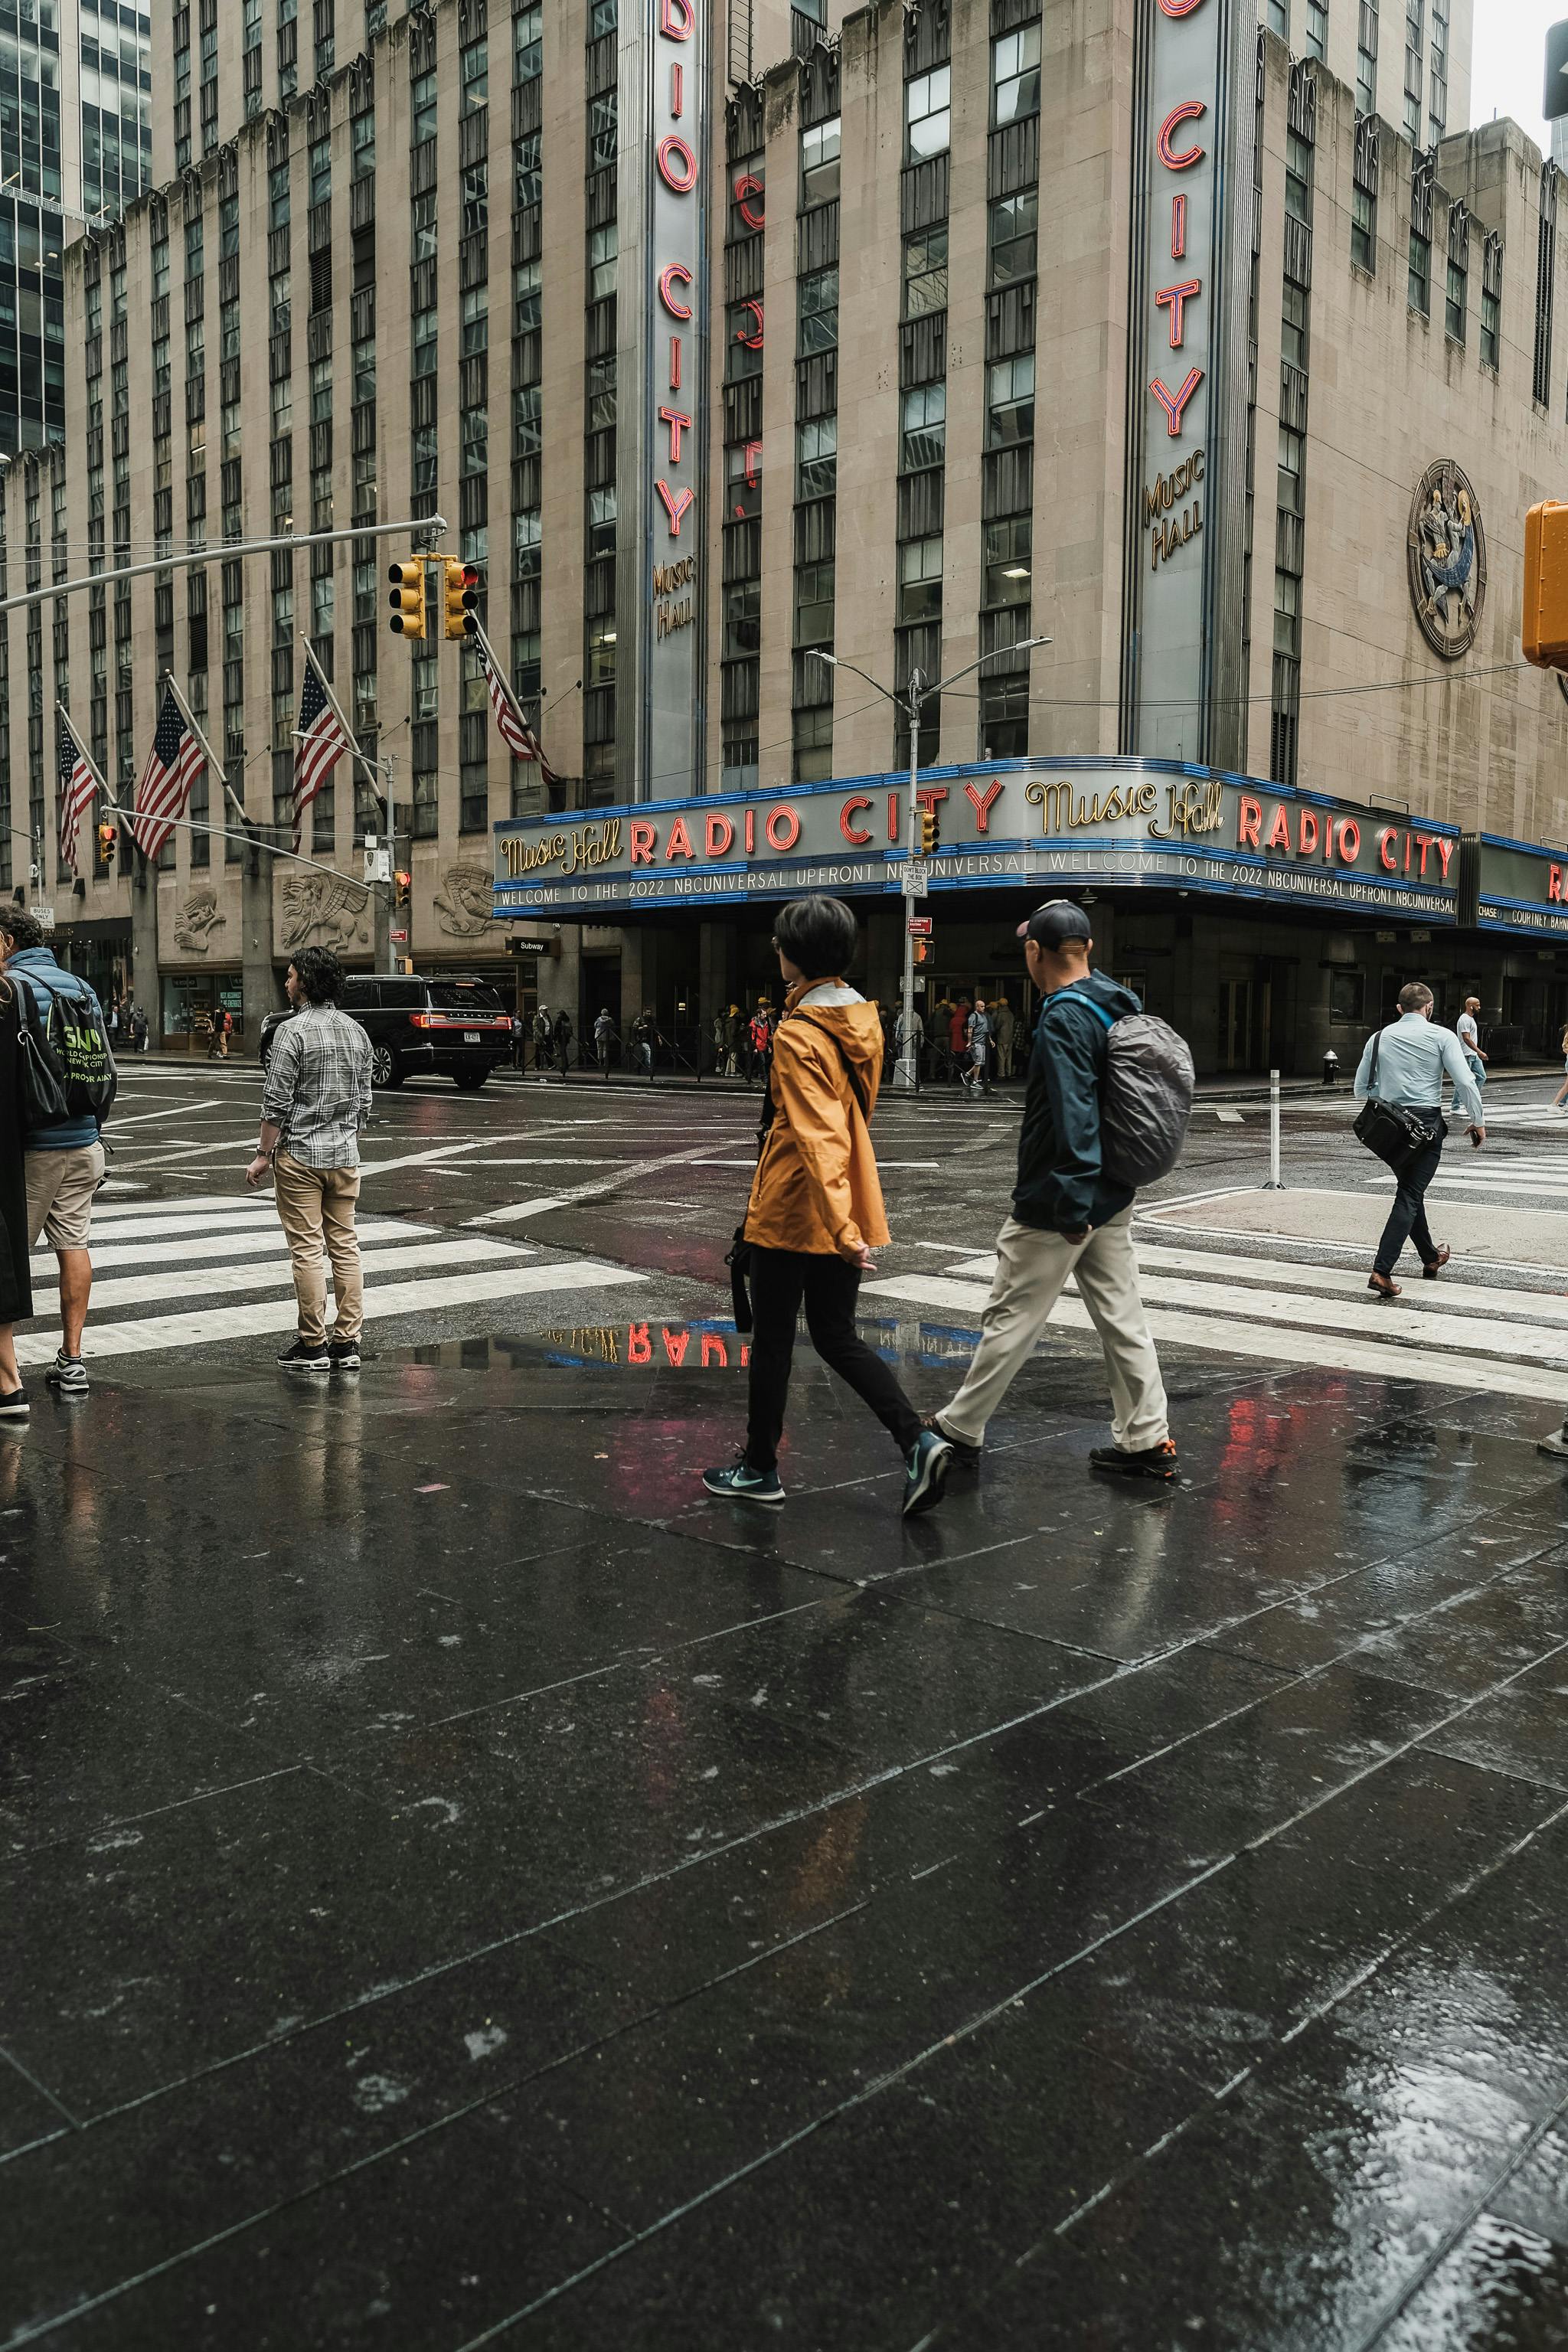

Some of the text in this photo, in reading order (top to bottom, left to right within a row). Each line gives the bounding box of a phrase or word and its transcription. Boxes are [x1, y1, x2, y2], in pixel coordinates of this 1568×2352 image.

[1149, 100, 1206, 438] CITY
[655, 262, 694, 537] CITY
[1145, 449, 1205, 529] MUSIC
[1152, 500, 1203, 570] HALL
[653, 556, 694, 599] MUSIC
[658, 597, 694, 640] HALL
[561, 817, 623, 874] Hall
[630, 804, 802, 864] RADIO
[840, 779, 1005, 844] CITY
[1148, 781, 1225, 838] Hall
[1237, 795, 1361, 864] RADIO
[1380, 827, 1453, 879] CITY
[501, 851, 1454, 913] WELCOME TO THE 2022 NBCUNIVERSAL UPFRONT NUNIVERSAL WELCOME TO THE 2022 NBCUNIVERSAL UPFRONT NBCUNIVERSAL
[1478, 906, 1497, 918] CHASE
[521, 942, 544, 951] Subway
[1512, 910, 1568, 930] COURTNEY BARN
